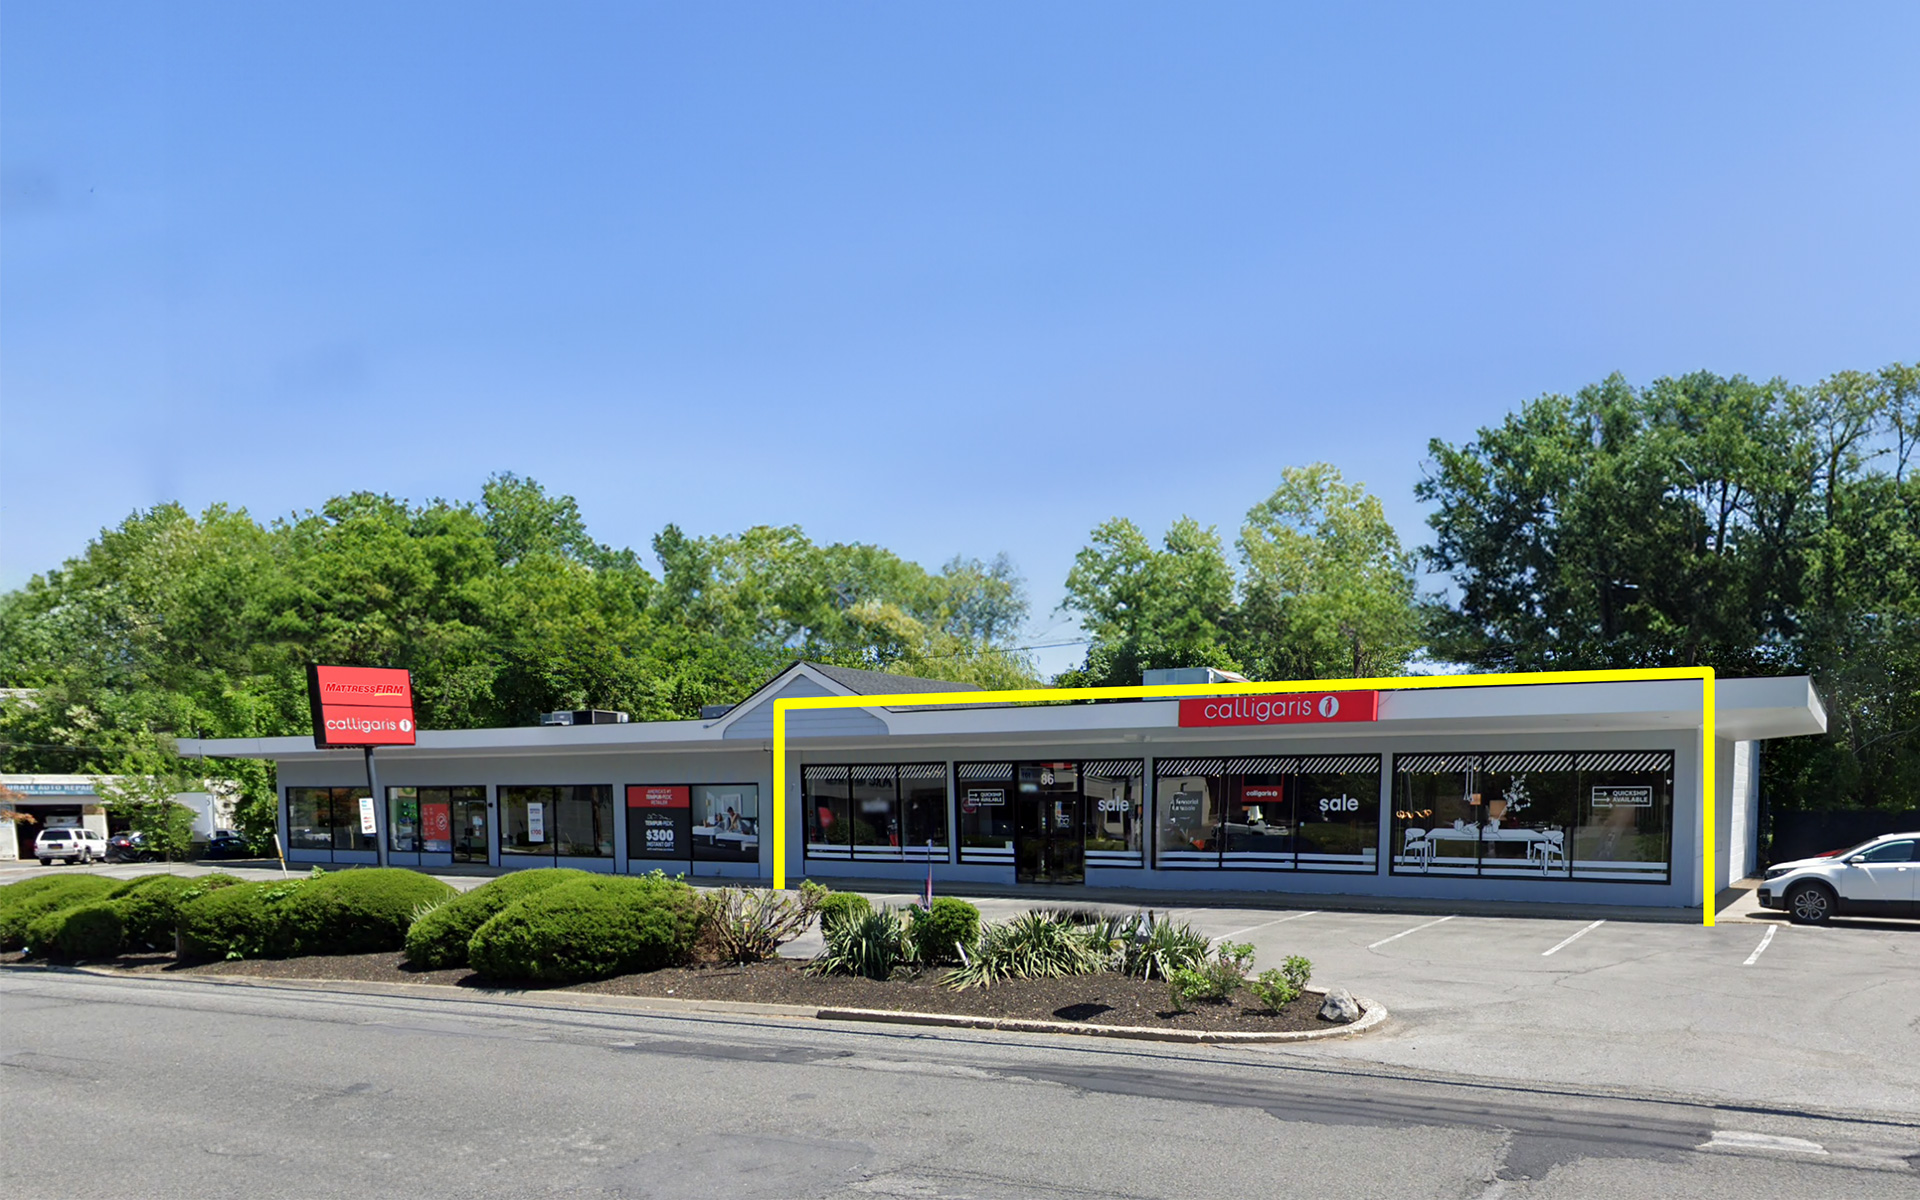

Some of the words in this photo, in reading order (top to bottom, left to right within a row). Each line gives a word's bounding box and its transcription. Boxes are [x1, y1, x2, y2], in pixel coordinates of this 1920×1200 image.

[1204, 697, 1312, 722] calligaris
[326, 717, 397, 734] calligaris
[1041, 773, 1054, 785] 86
[1246, 790, 1272, 798] calligaris
[1097, 796, 1129, 811] sale
[1319, 793, 1359, 811] sale
[646, 829, 674, 841] $300
